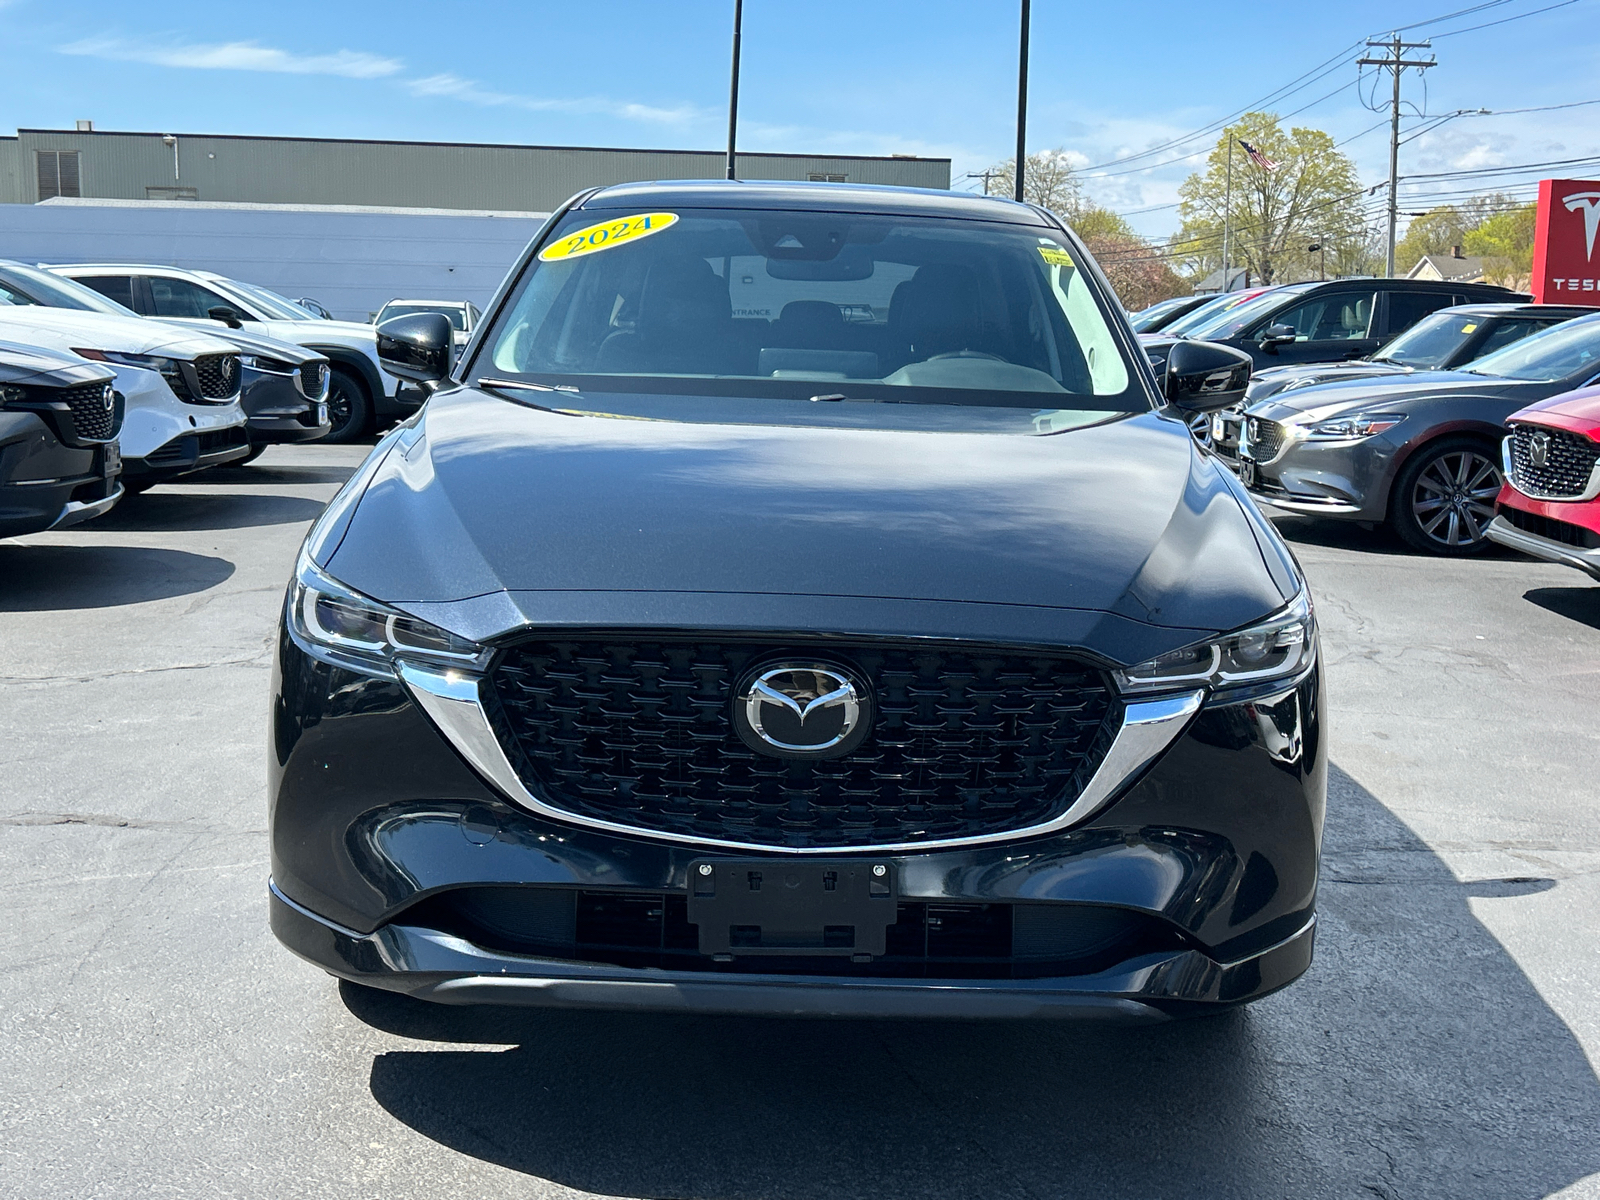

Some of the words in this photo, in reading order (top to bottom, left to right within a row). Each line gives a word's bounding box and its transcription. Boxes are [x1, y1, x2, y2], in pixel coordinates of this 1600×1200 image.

[567, 216, 655, 255] 2024
[1552, 278, 1600, 291] TES
[731, 308, 772, 316] NTRANCE
